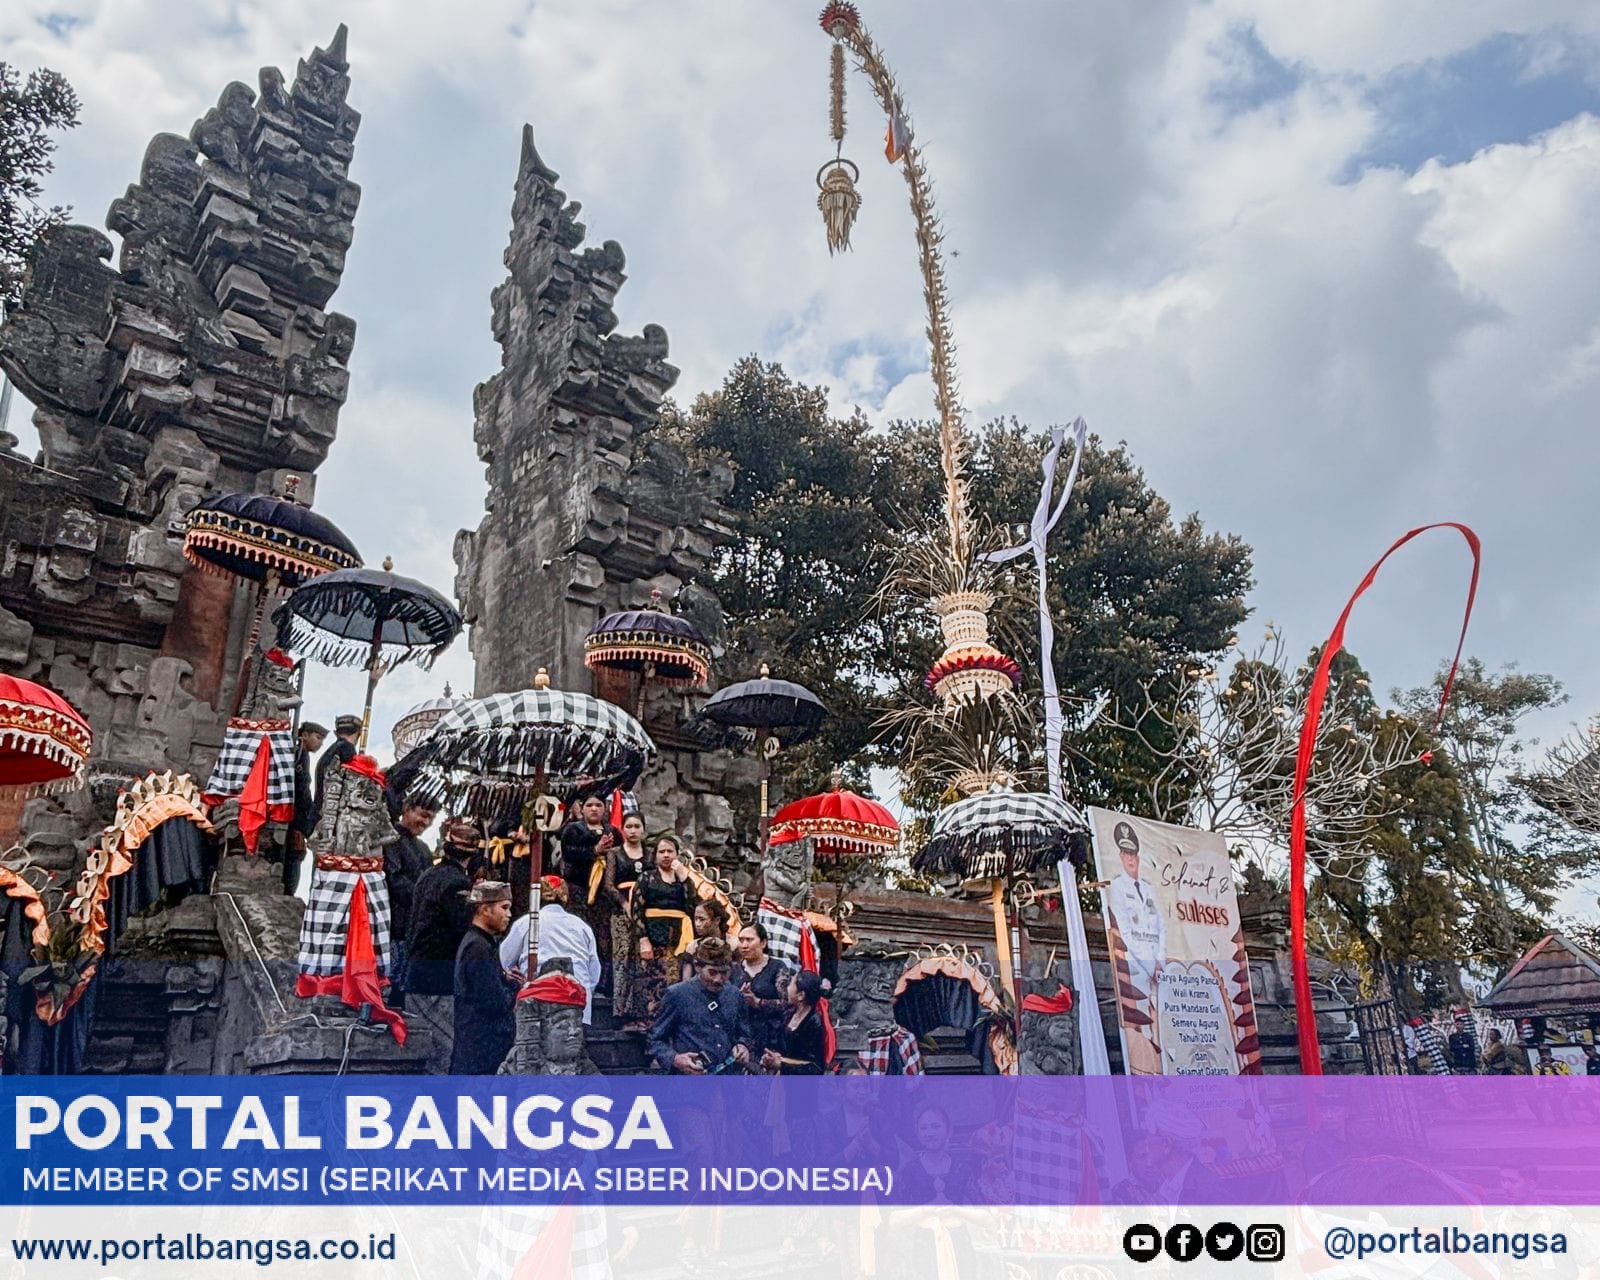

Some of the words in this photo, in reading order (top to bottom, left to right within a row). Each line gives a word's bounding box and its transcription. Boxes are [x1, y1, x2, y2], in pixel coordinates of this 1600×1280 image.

[1161, 861, 1215, 895] Selamat
[1219, 877, 1229, 894] &
[1178, 974, 1200, 986] Agung
[1189, 989, 1210, 999] Krama
[1164, 1002, 1180, 1013] Pura
[1181, 1003, 1209, 1014] Mandara
[1171, 1017, 1198, 1028] Semeru
[1198, 1019, 1220, 1030] Agung
[1178, 1032, 1199, 1043] Tahun
[1199, 1033, 1217, 1043] 2024
[1194, 1052, 1208, 1061] dan
